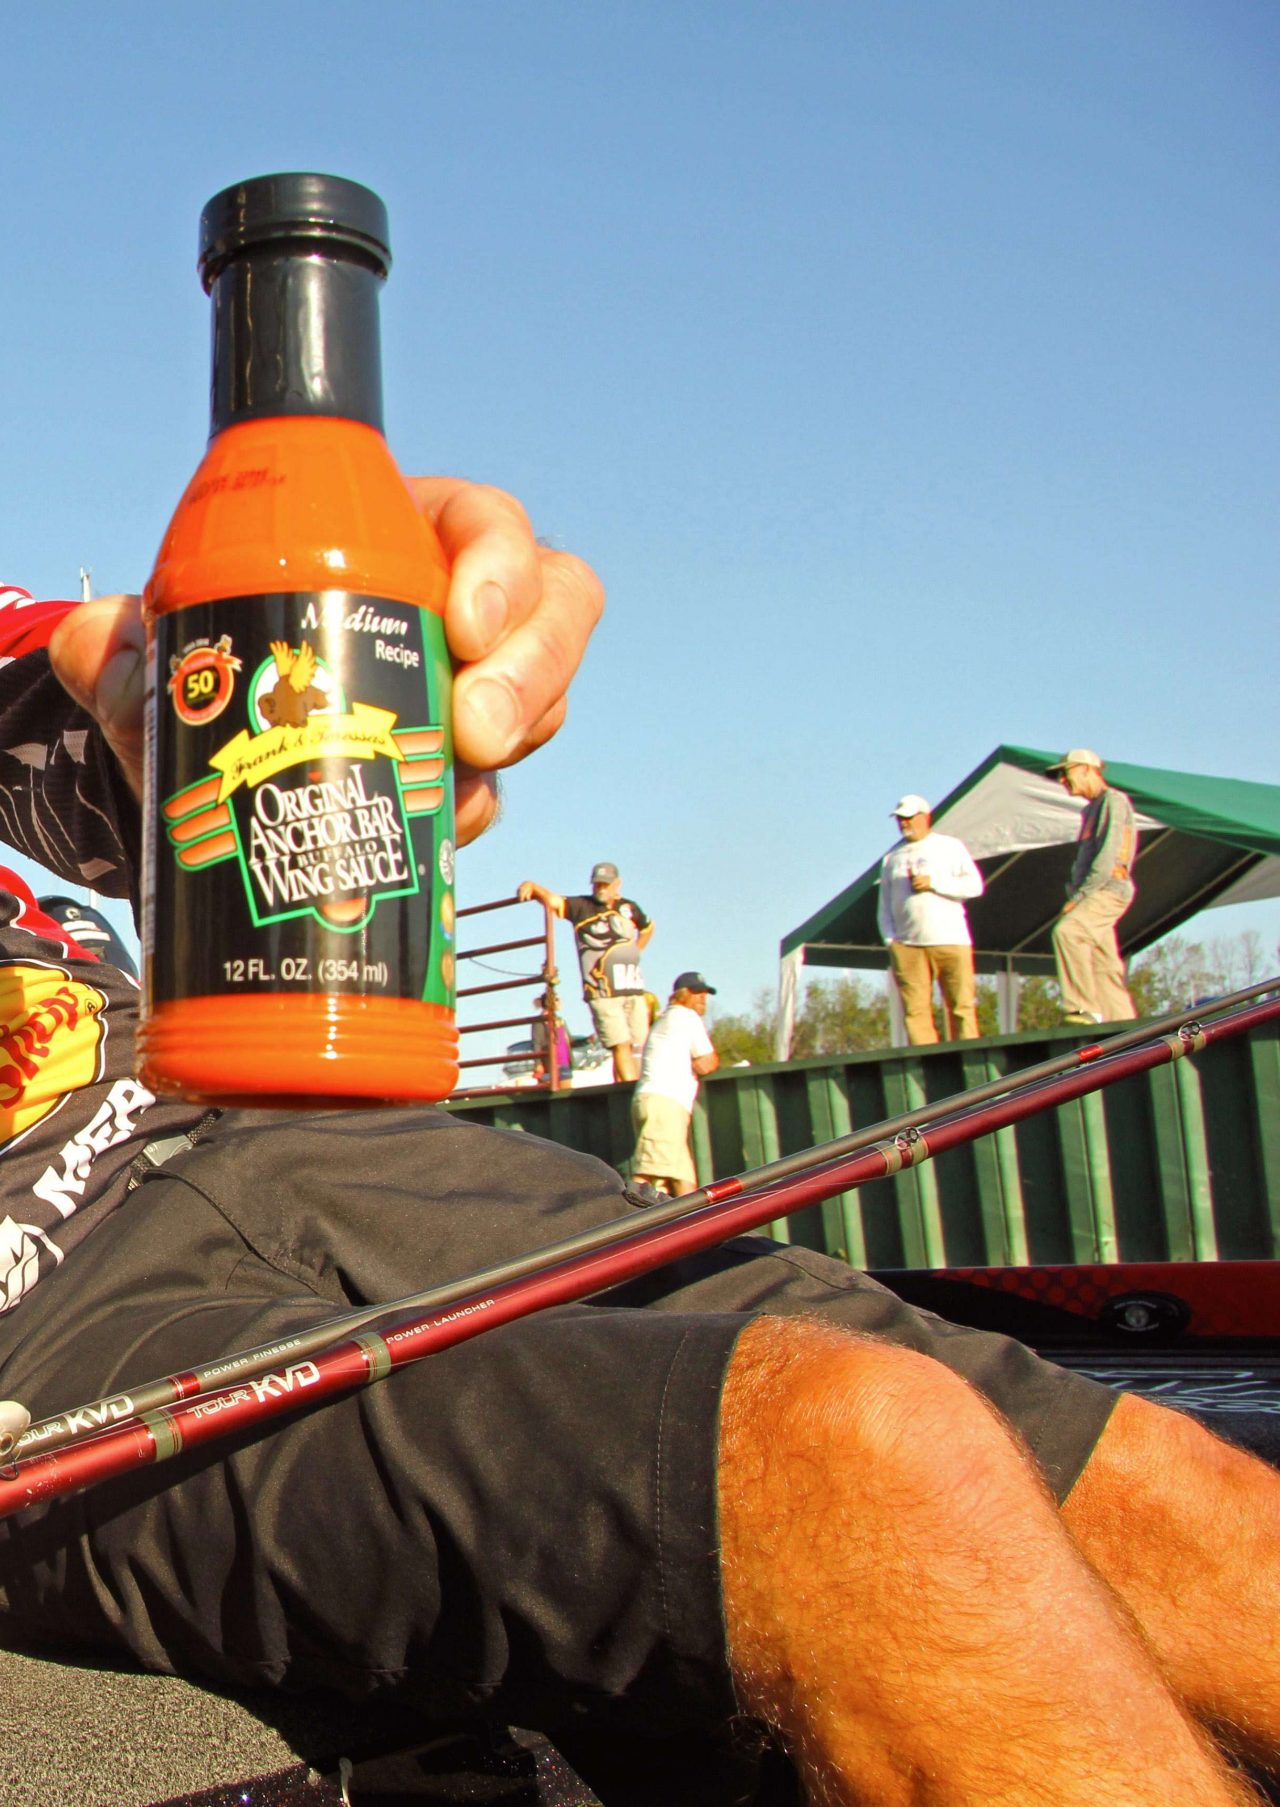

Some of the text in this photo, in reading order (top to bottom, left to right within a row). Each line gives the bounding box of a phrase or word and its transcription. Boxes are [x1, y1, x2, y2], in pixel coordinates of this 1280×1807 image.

[301, 602, 408, 636] Mdium
[375, 639, 420, 668] Recipe
[187, 669, 215, 699] 50
[254, 764, 378, 828] ORIGINAL
[249, 796, 404, 865] ANCHOR BAR
[251, 855, 336, 907] WING
[335, 834, 409, 890] SAUCE
[298, 840, 378, 868] BUFFALO
[223, 957, 389, 988] 12 FL. OZ. (354 ml)
[385, 1298, 496, 1345] POWER LAUNCHER
[202, 1338, 302, 1378] POWER FINESSE
[186, 1360, 321, 1420] TOUR KVD
[17, 1393, 135, 1447] OUR KVD
